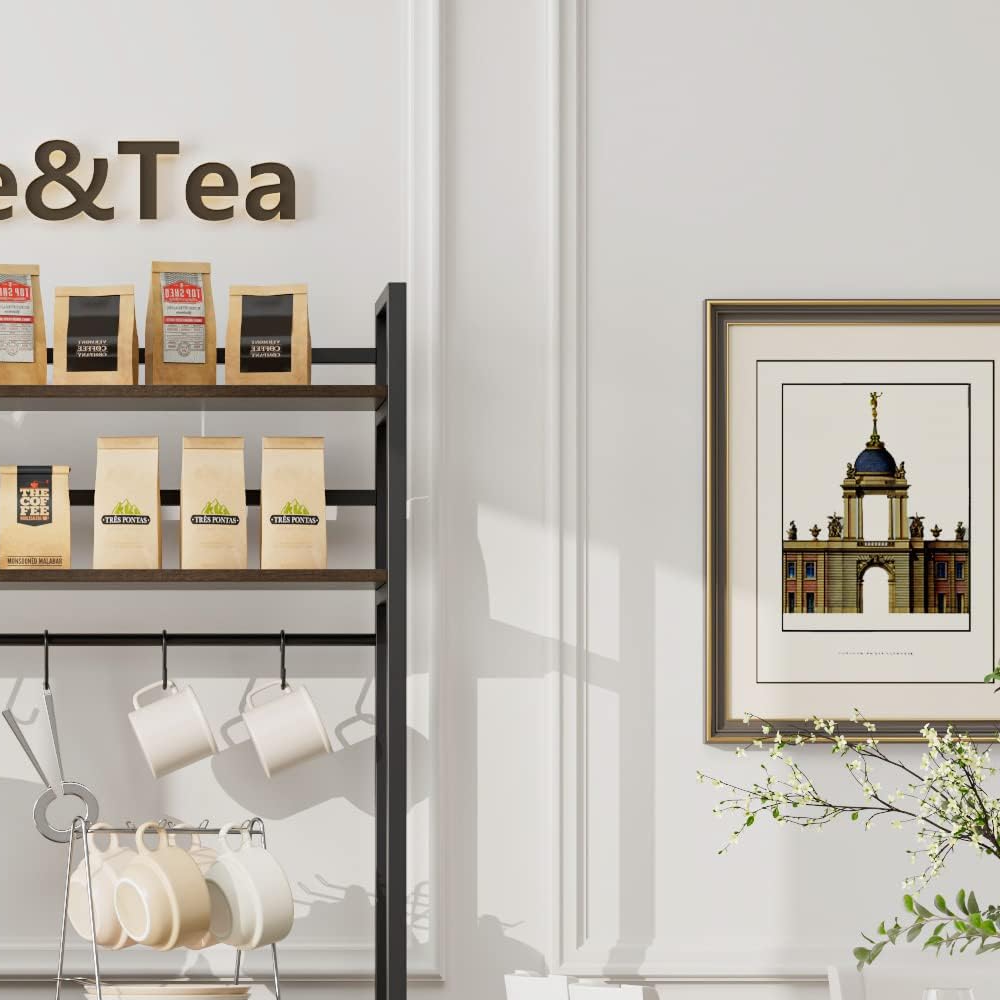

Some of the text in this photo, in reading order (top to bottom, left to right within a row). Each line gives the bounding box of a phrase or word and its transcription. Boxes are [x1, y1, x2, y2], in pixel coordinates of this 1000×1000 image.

[19, 488, 50, 497] THE
[19, 496, 50, 506] COF
[19, 506, 50, 516] FEE
